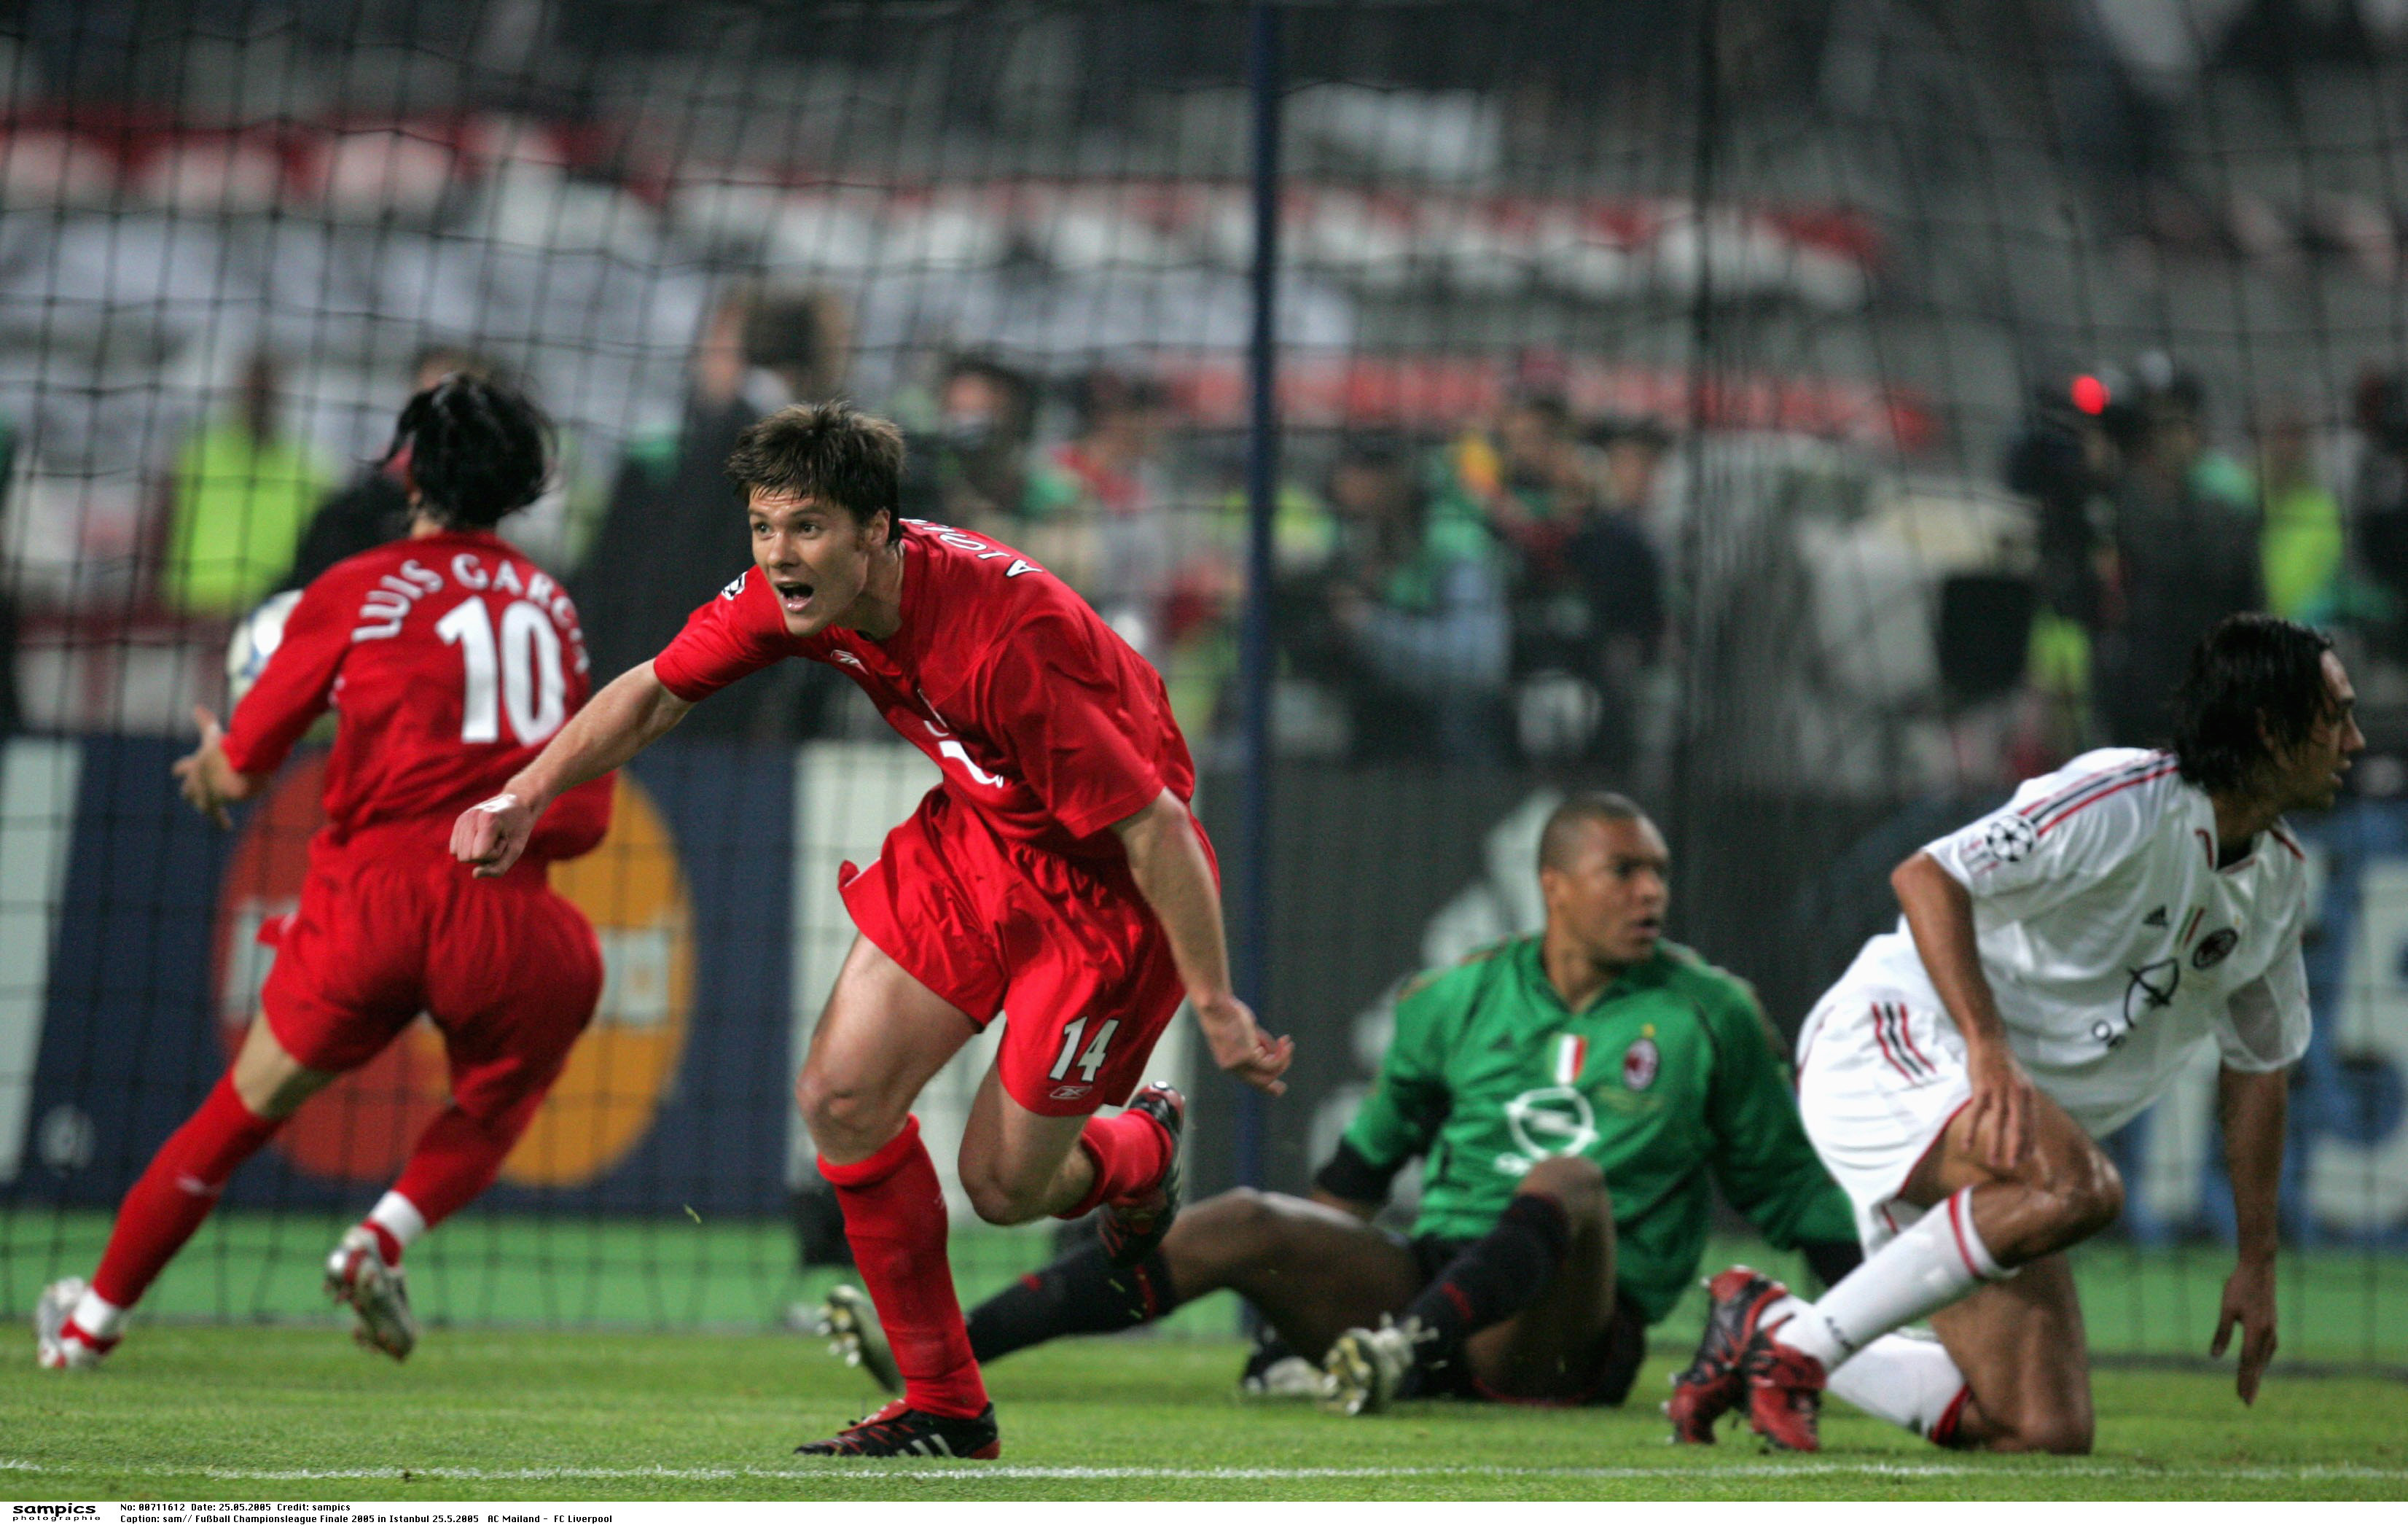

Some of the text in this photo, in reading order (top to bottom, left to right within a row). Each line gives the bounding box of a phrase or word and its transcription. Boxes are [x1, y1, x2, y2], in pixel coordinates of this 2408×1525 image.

[351, 559, 444, 642] LUIS
[435, 595, 566, 747] 10
[1048, 1016, 1119, 1083] 14
